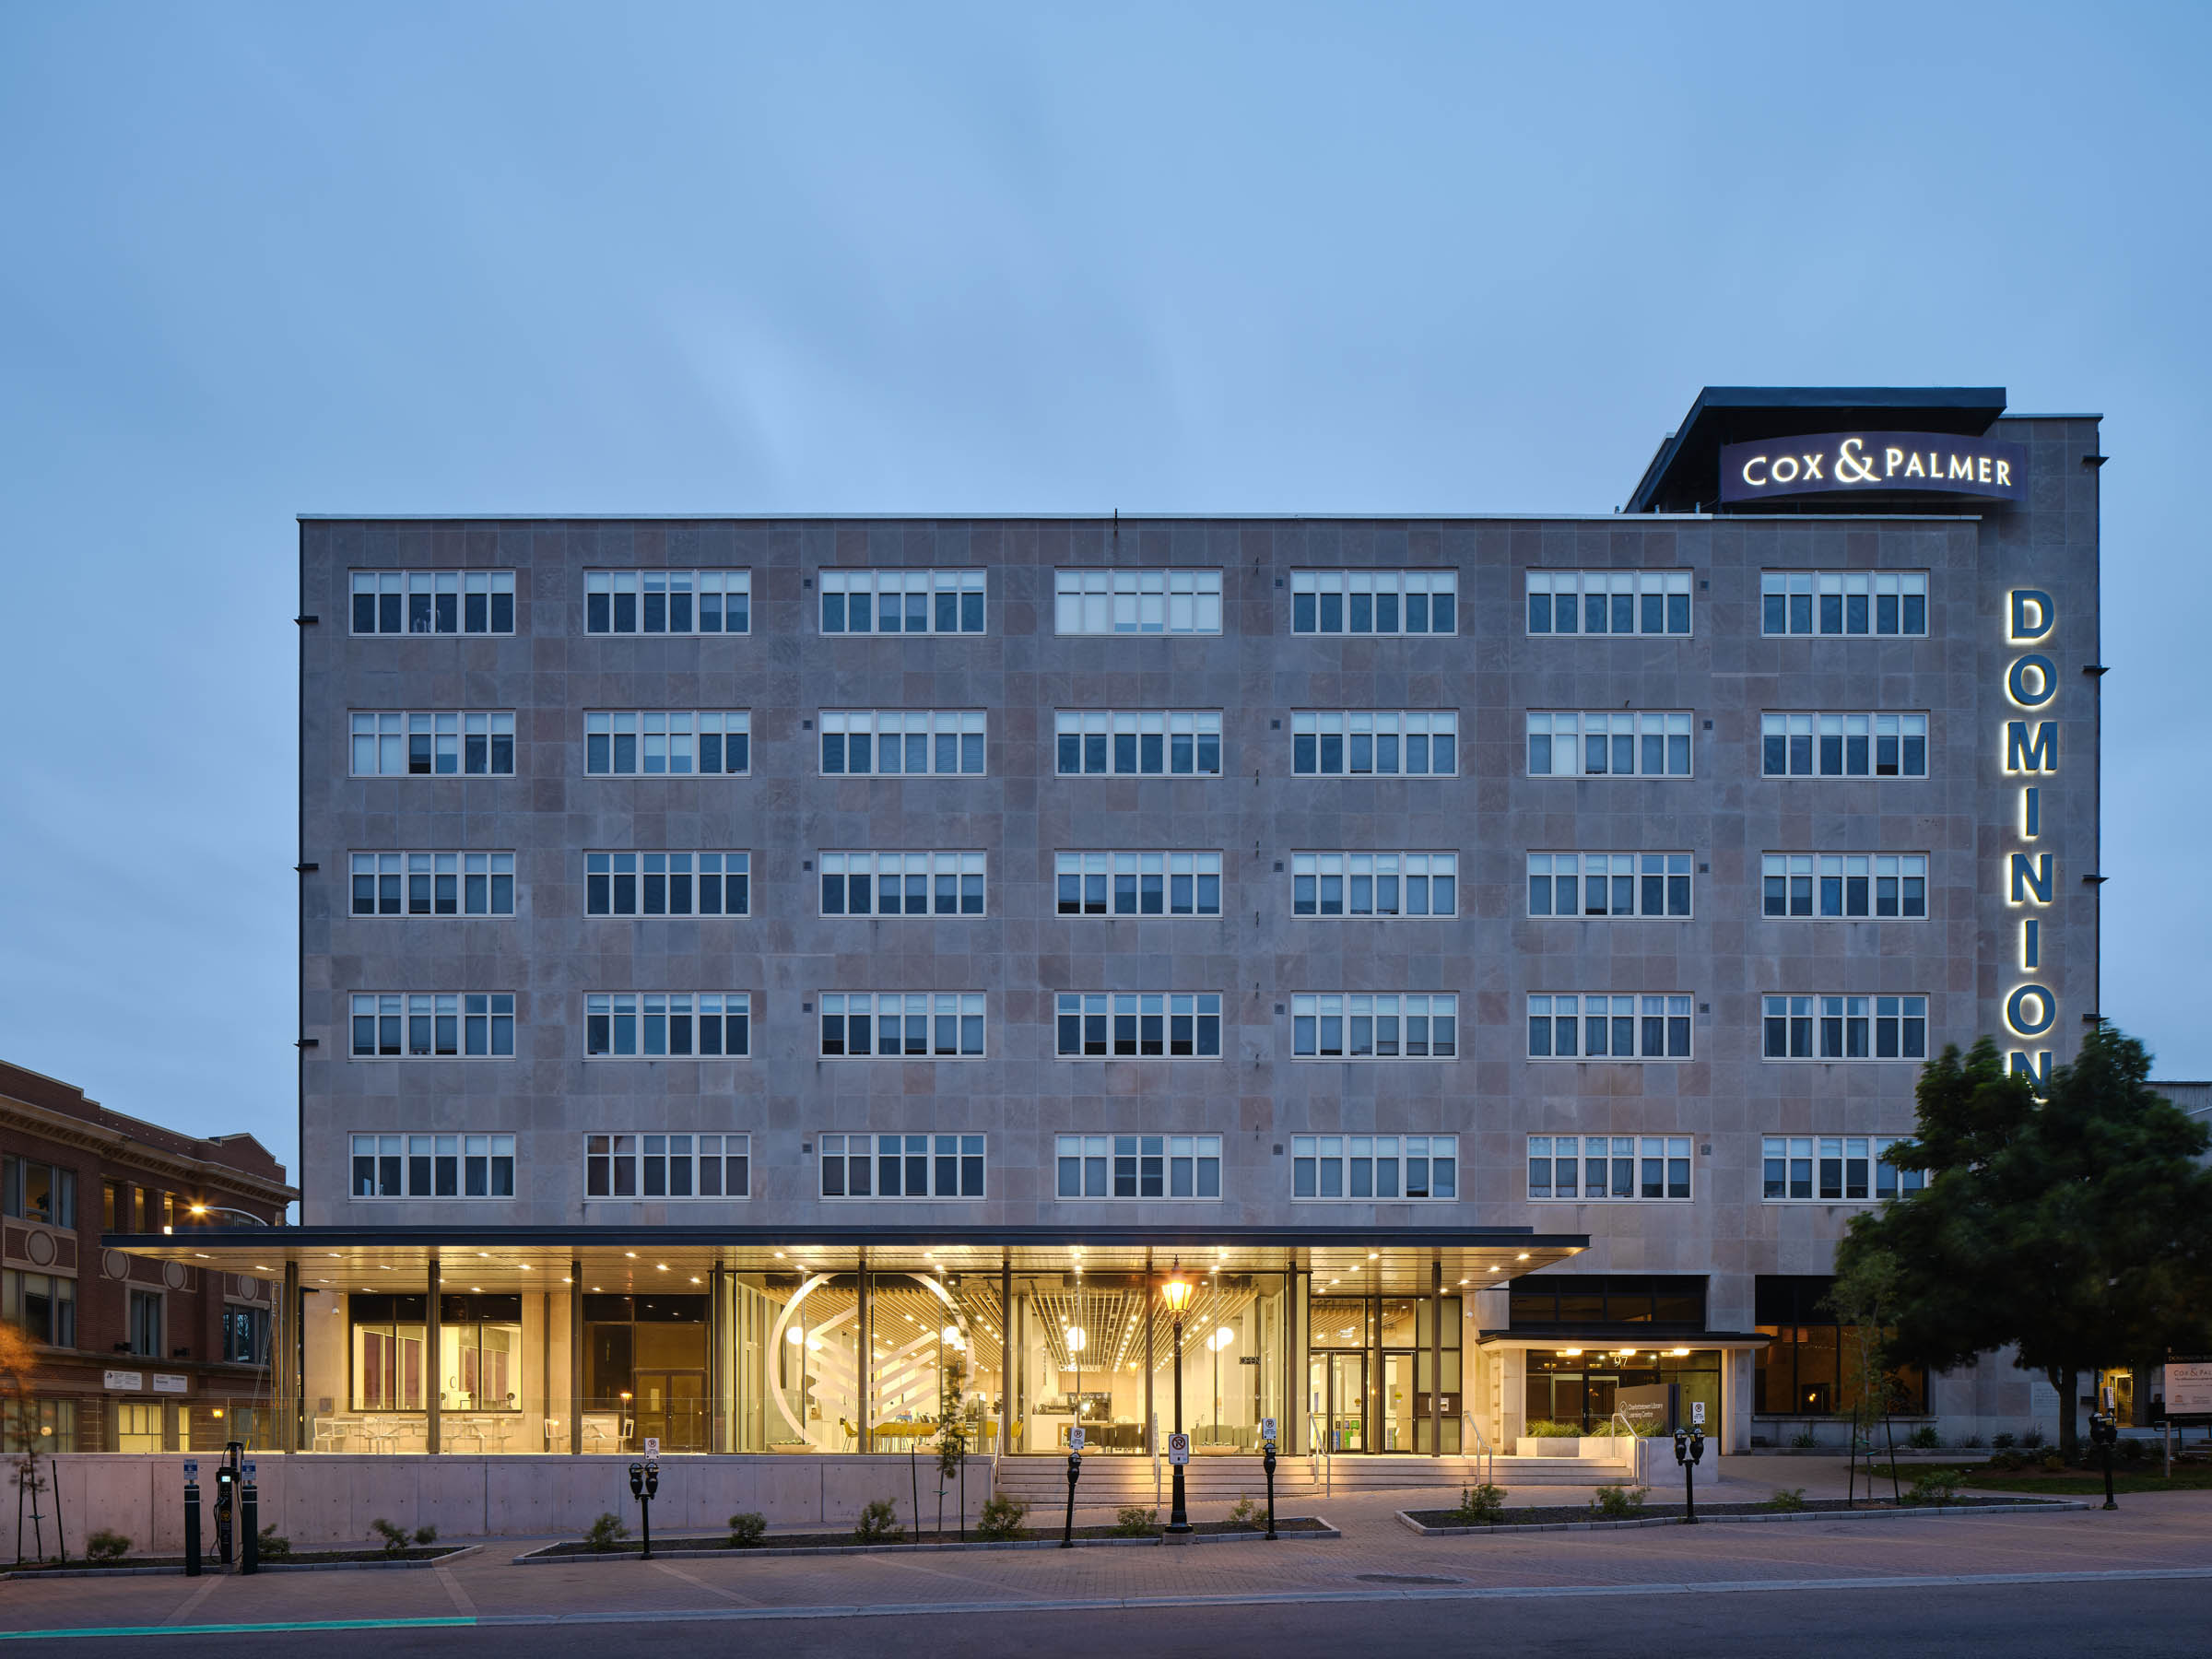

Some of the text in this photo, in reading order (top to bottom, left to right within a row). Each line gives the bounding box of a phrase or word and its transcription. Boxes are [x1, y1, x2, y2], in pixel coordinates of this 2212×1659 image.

[1742, 438, 2012, 487] COX & PALMER
[1614, 1356, 1629, 1367] 97
